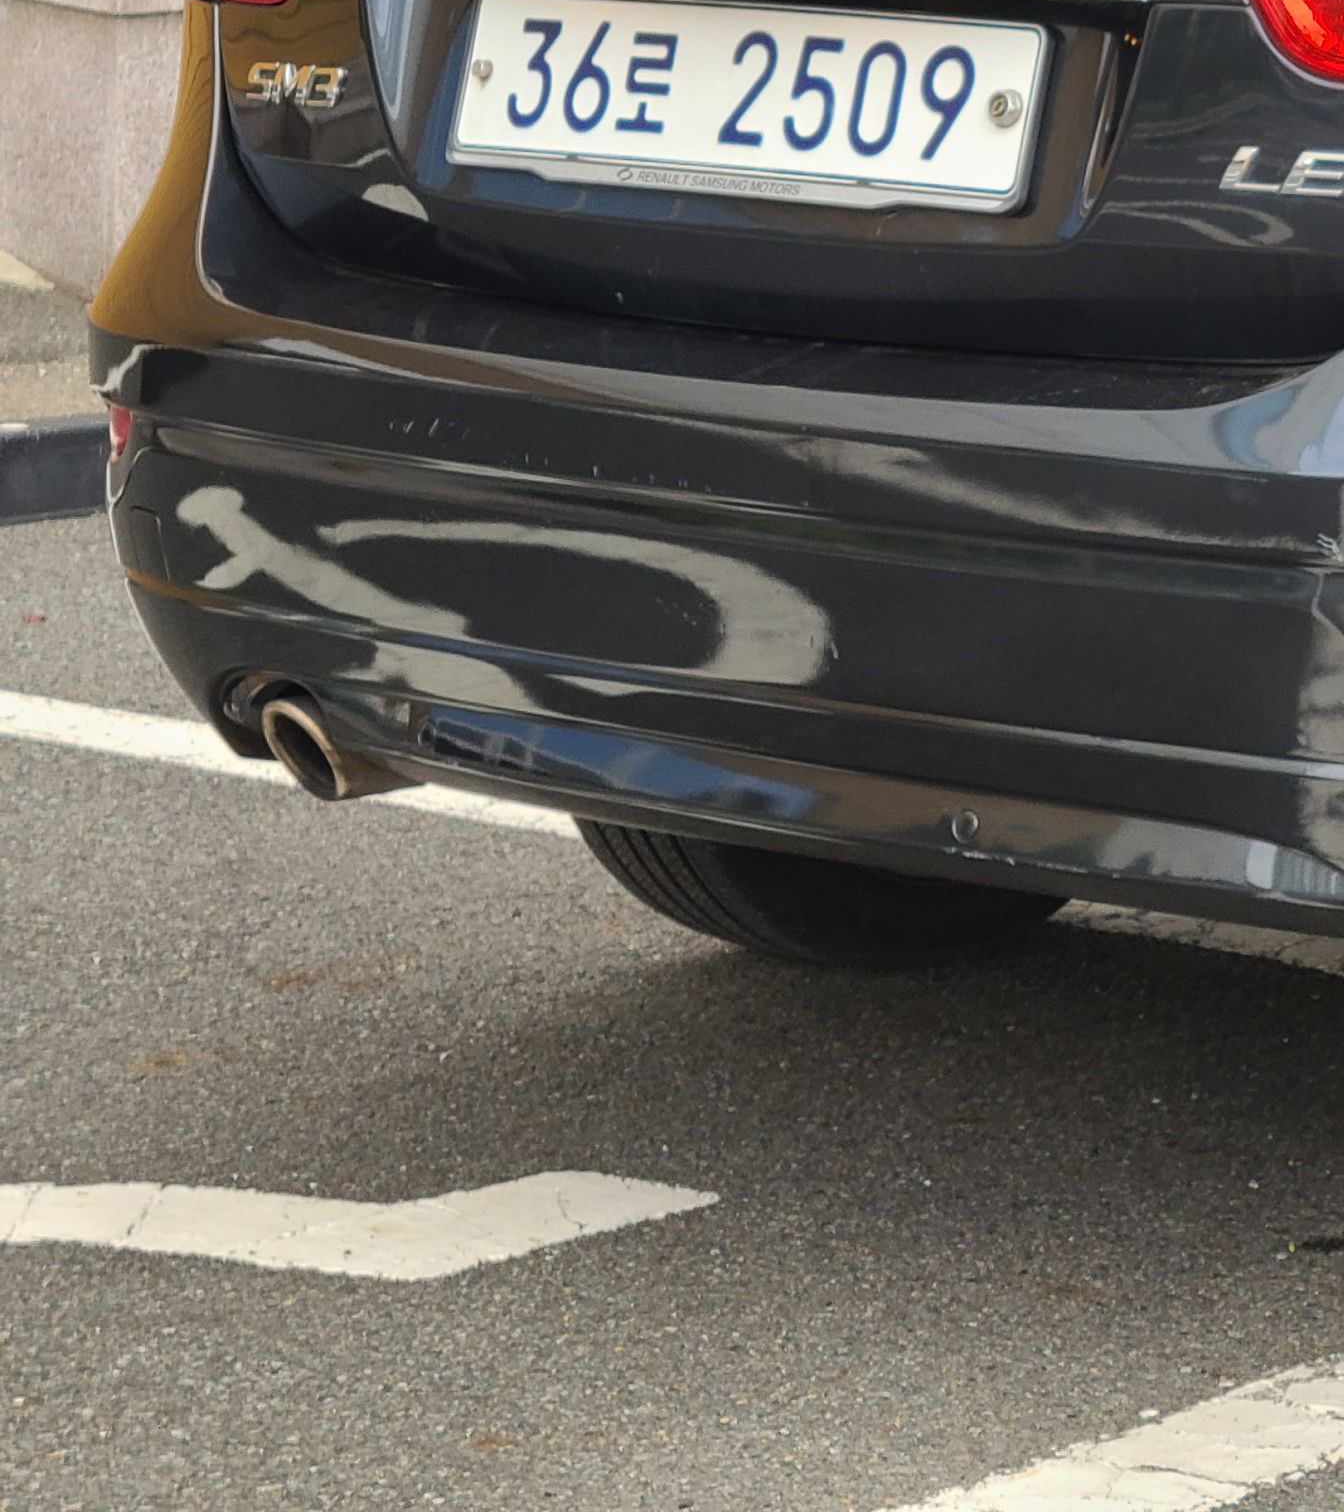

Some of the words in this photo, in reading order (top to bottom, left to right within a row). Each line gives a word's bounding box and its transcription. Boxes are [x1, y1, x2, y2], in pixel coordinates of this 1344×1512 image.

[246, 61, 347, 108] SM3
[506, 18, 680, 134] 36로
[717, 31, 977, 161] 2509
[637, 171, 689, 186] RENAULT
[690, 176, 750, 191] SAMSUNG
[750, 180, 802, 196] MOTORS
